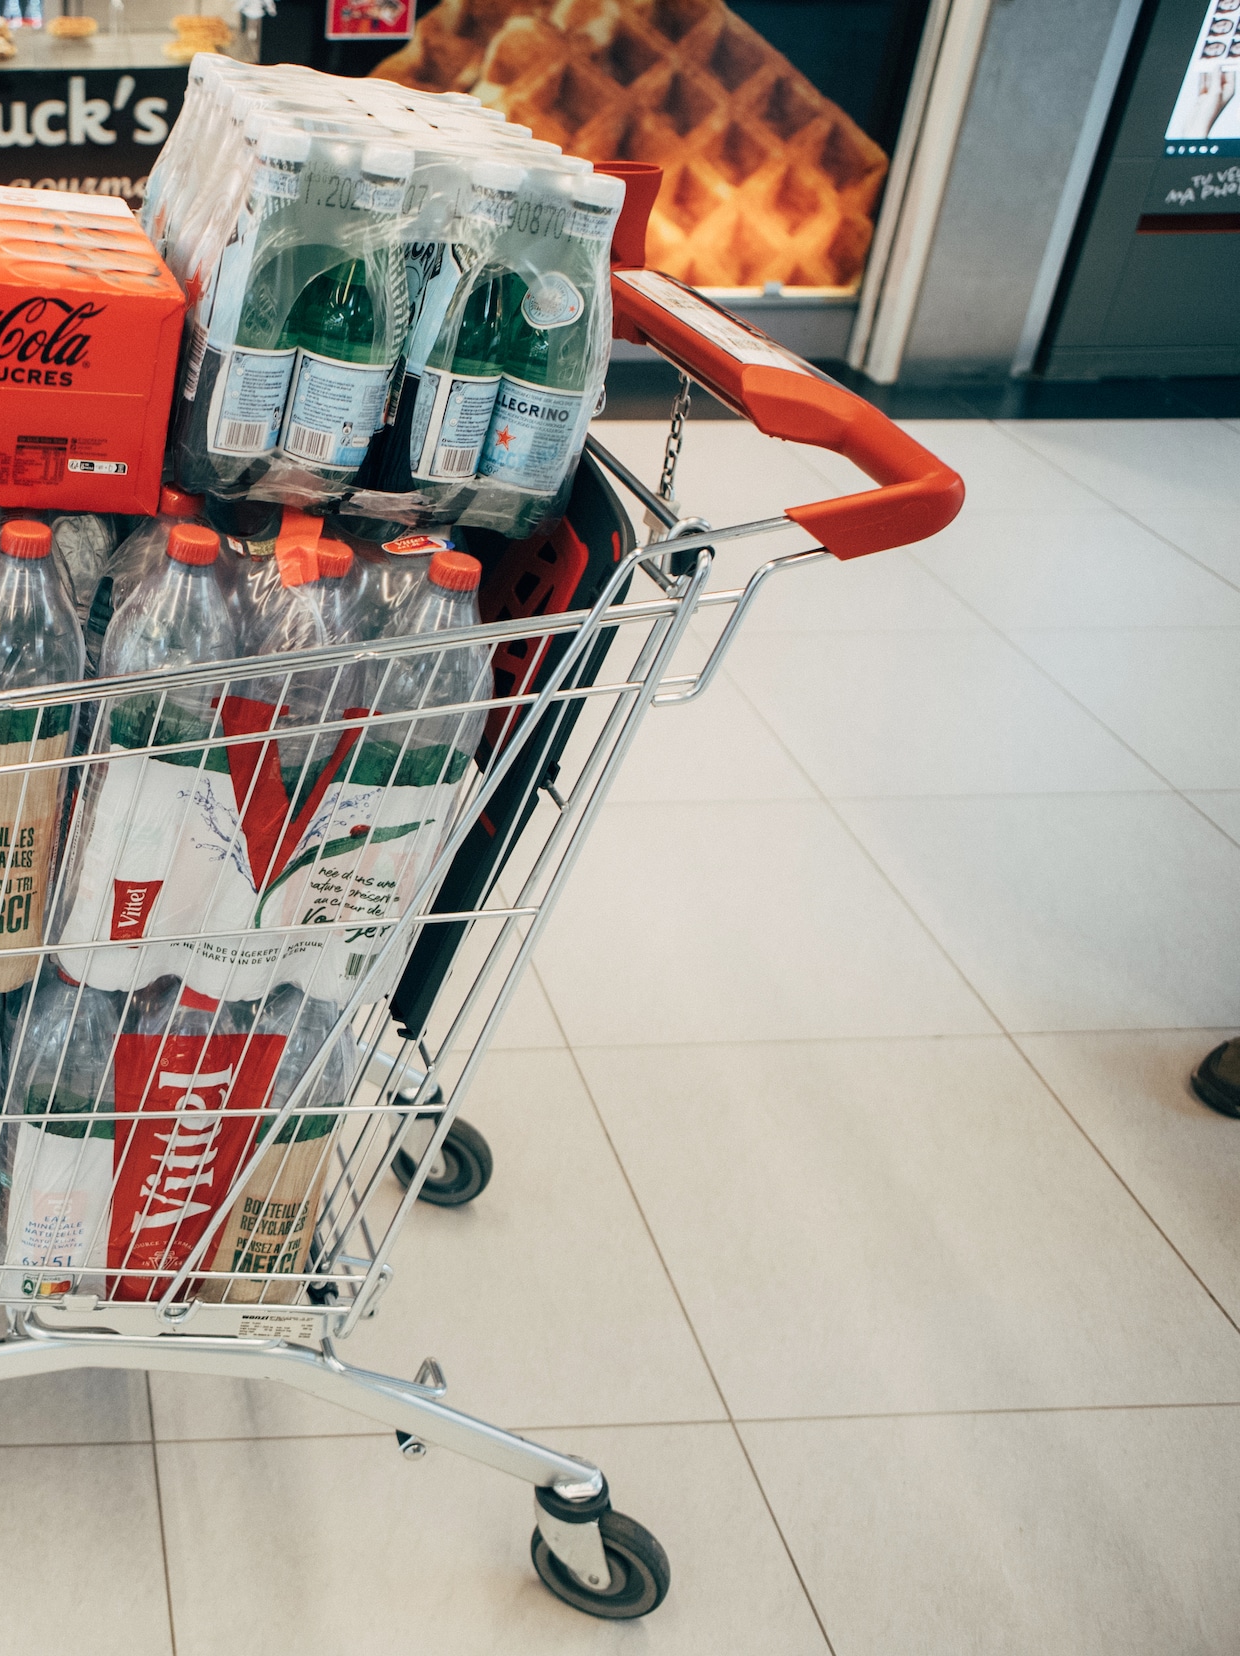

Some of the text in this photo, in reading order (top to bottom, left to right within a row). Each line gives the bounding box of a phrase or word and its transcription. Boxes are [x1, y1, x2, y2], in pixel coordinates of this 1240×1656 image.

[319, 866, 340, 878] née
[17, 876, 34, 894] TRI
[117, 888, 148, 929] Vittel
[202, 951, 227, 963] HART
[251, 957, 262, 965] DE
[265, 946, 307, 963] VOEZEN
[216, 945, 228, 955] DE
[130, 1062, 233, 1233] Vittel
[28, 1221, 83, 1231] MINÉALE
